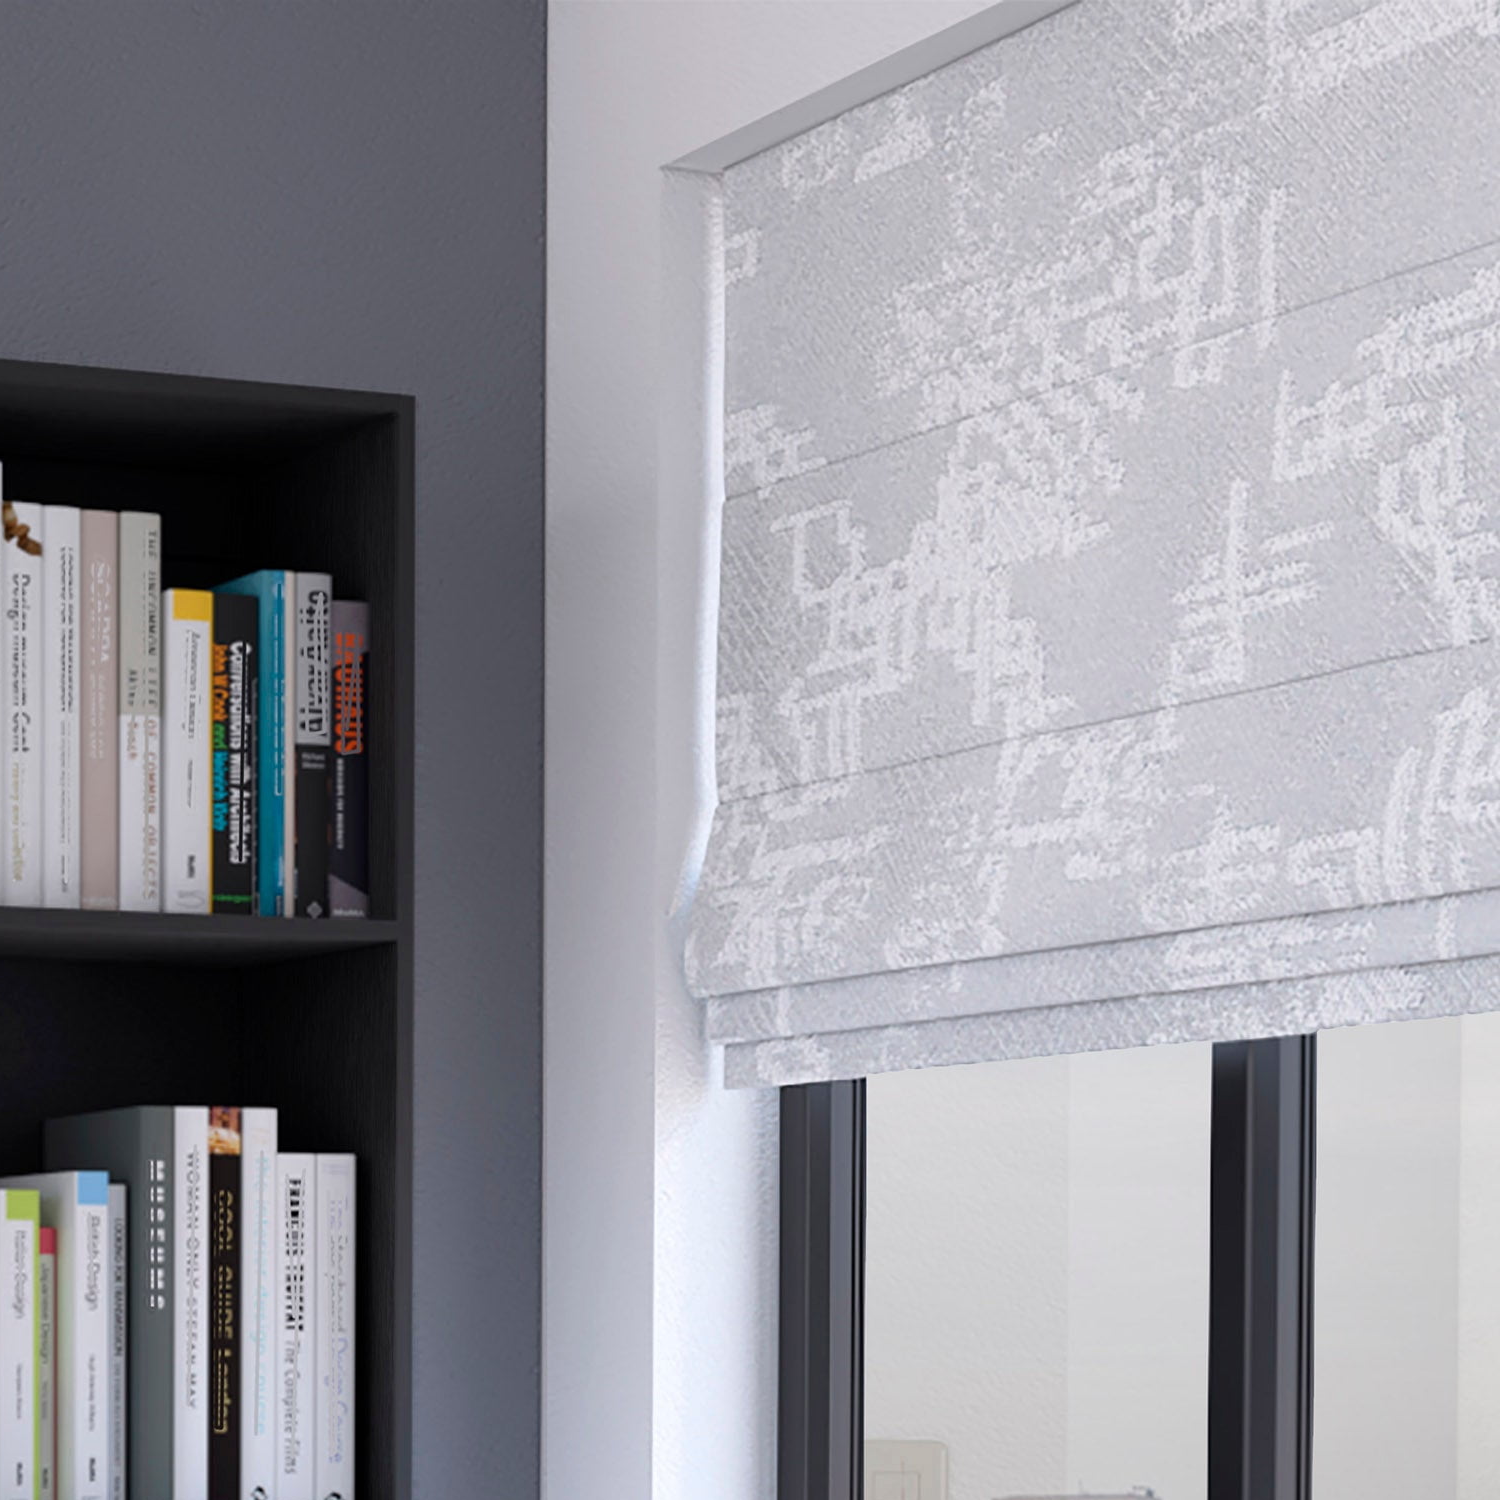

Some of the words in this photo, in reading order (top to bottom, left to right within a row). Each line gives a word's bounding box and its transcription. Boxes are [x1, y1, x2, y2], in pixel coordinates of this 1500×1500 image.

[229, 641, 252, 749] Conversations
[334, 632, 363, 754] BAUHAUS
[230, 753, 251, 785] with
[148, 1159, 165, 1309] MUSEUMS
[214, 1189, 234, 1252] COOL
[214, 1265, 234, 1339] GUIDE
